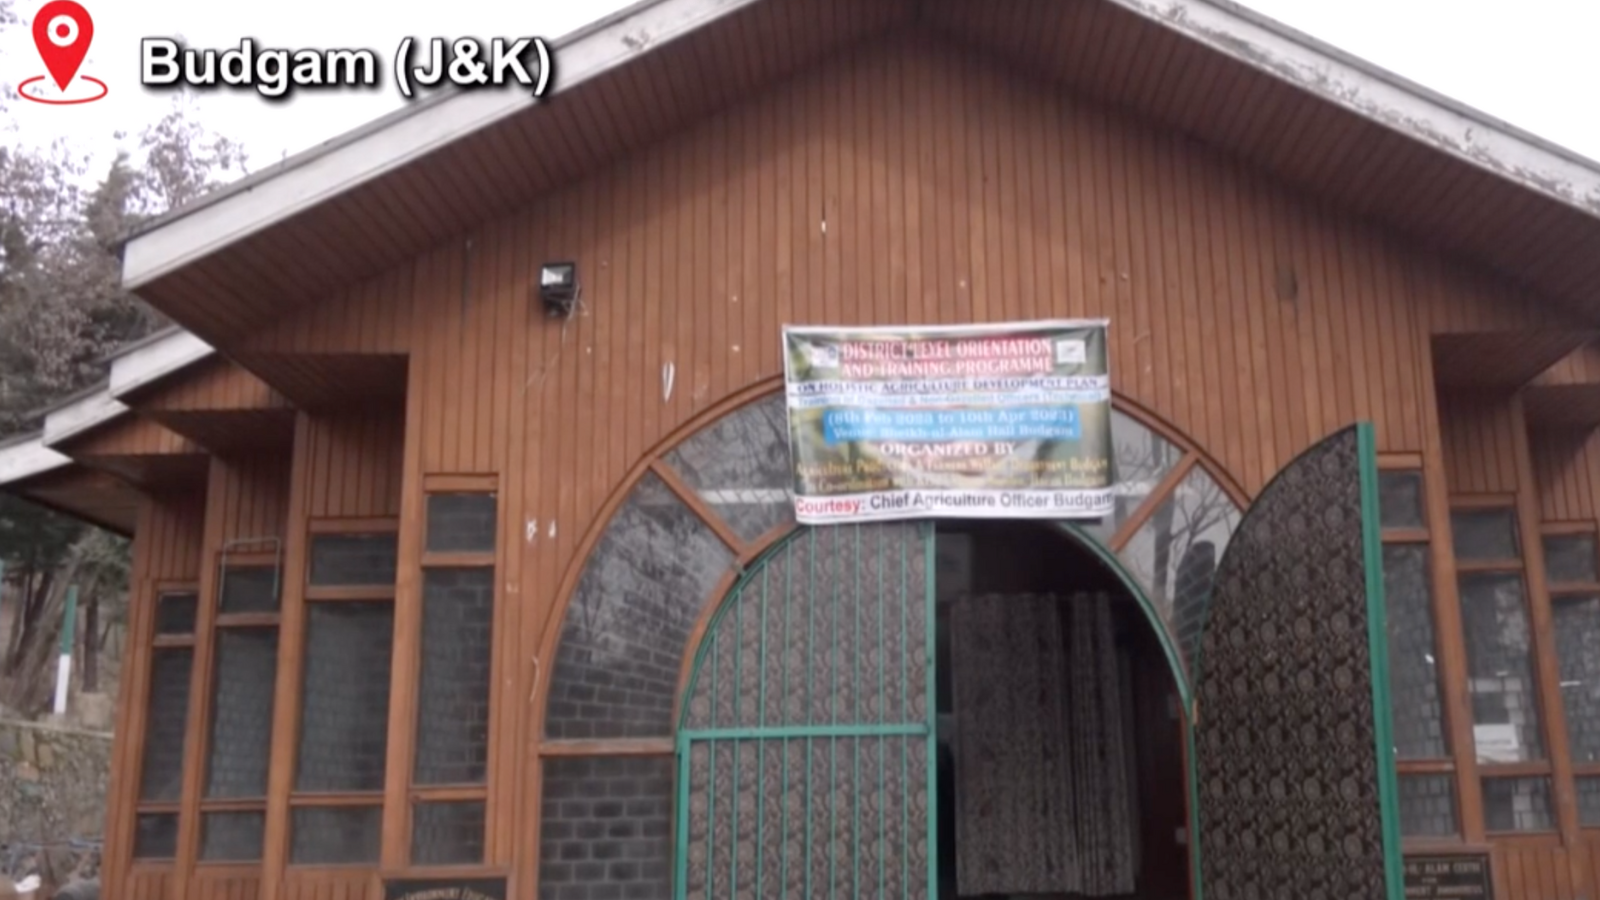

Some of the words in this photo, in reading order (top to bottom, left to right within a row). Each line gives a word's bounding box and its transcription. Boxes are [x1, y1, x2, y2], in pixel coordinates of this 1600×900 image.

[843, 342, 908, 360] DISTRICT
[913, 341, 950, 359] LEVEL
[957, 339, 1051, 357] ORIENTATION
[843, 362, 873, 377] AND
[879, 361, 951, 376] TRAINING
[956, 358, 1053, 374] PROGRAMME
[798, 383, 816, 393] ON
[819, 381, 874, 393] HOLISTIC
[882, 379, 966, 393] AGRICULTURE
[973, 378, 1061, 390] DEVELOPMENT
[1066, 378, 1098, 389] PLAN
[864, 411, 892, 424] Feb
[938, 411, 953, 424] to
[960, 410, 994, 424] 10th
[998, 410, 1025, 425] Apr
[987, 425, 1015, 436] Hall
[881, 443, 987, 456] ORGANIZED
[995, 442, 1015, 455] BY
[796, 498, 866, 514] Courtesy:
[870, 493, 909, 510] Chief
[913, 493, 995, 510] Agriculture
[1000, 492, 1049, 508] Officer
